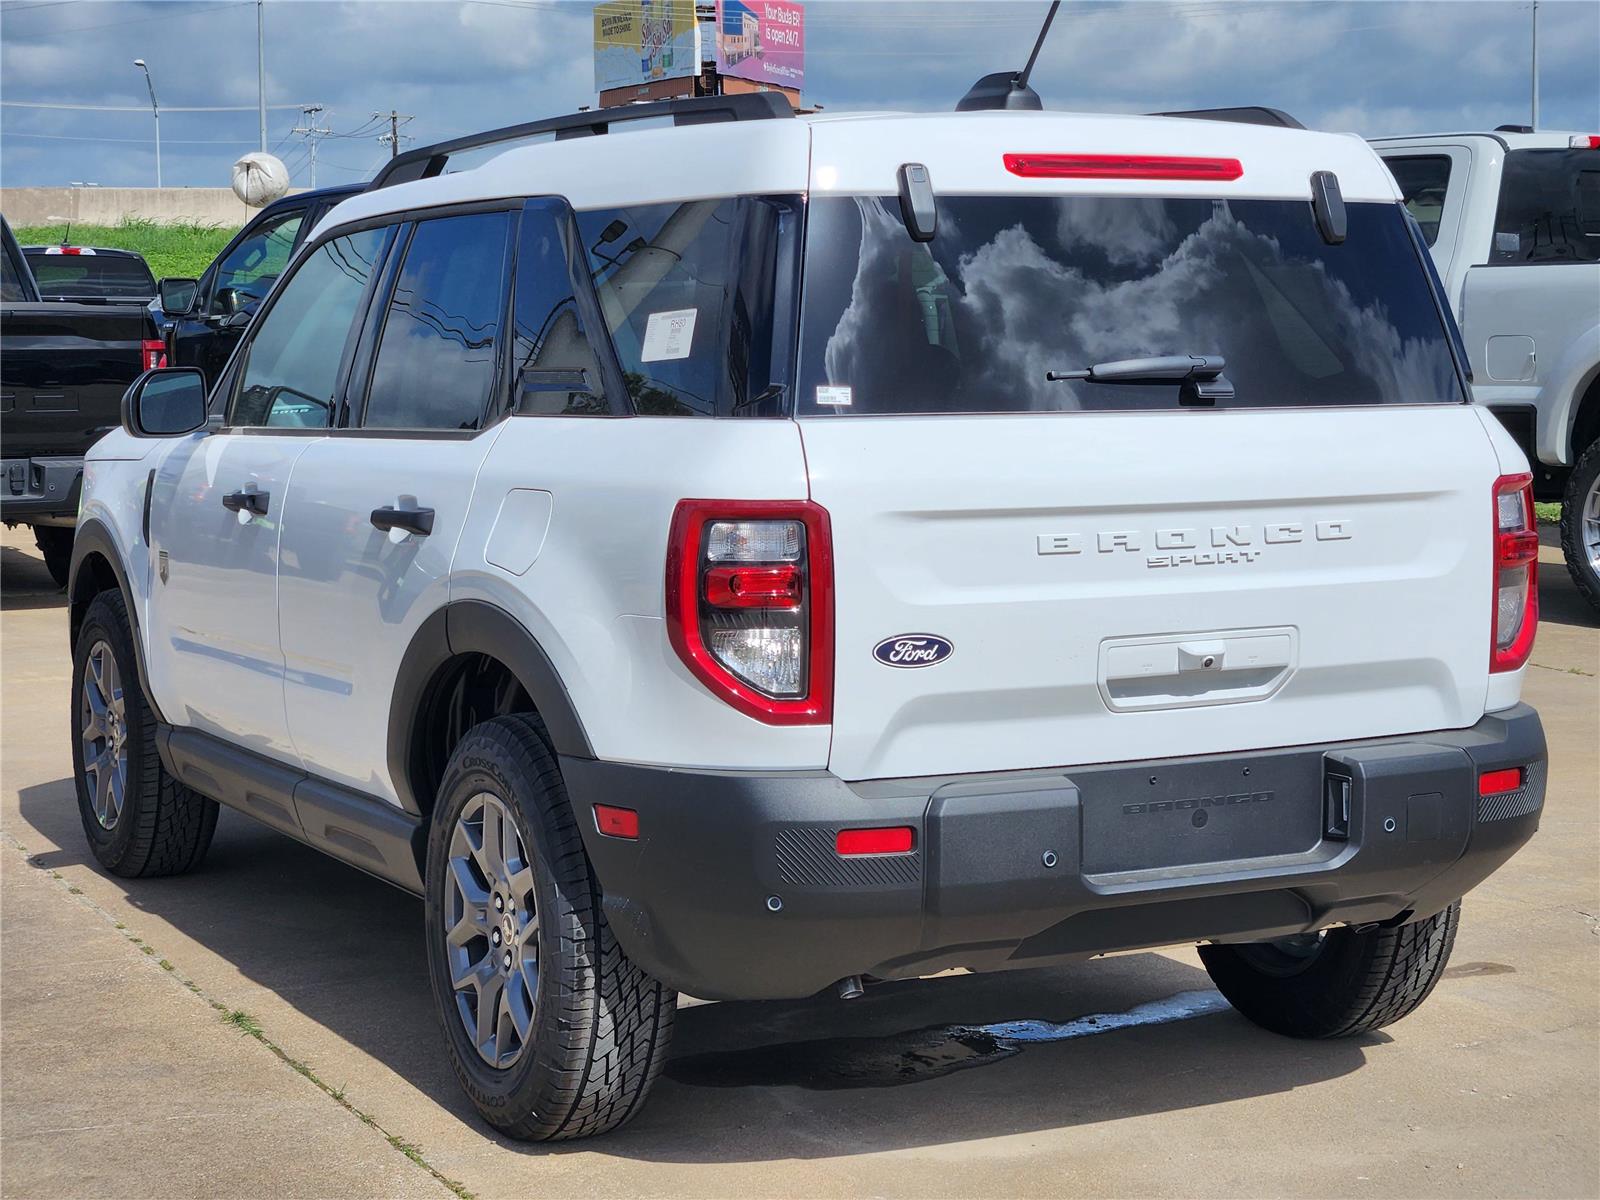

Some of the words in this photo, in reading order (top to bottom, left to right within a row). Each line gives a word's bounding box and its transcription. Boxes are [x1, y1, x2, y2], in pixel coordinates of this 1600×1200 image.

[764, 2, 777, 20] Your
[777, 6, 792, 25] Buda
[792, 10, 800, 27] ER
[765, 22, 771, 40] is
[771, 28, 786, 46] open
[1037, 520, 1352, 556] BRONCO
[1147, 551, 1261, 568] SPORT
[889, 640, 939, 662] Ford
[1122, 790, 1275, 815] BRONCO
